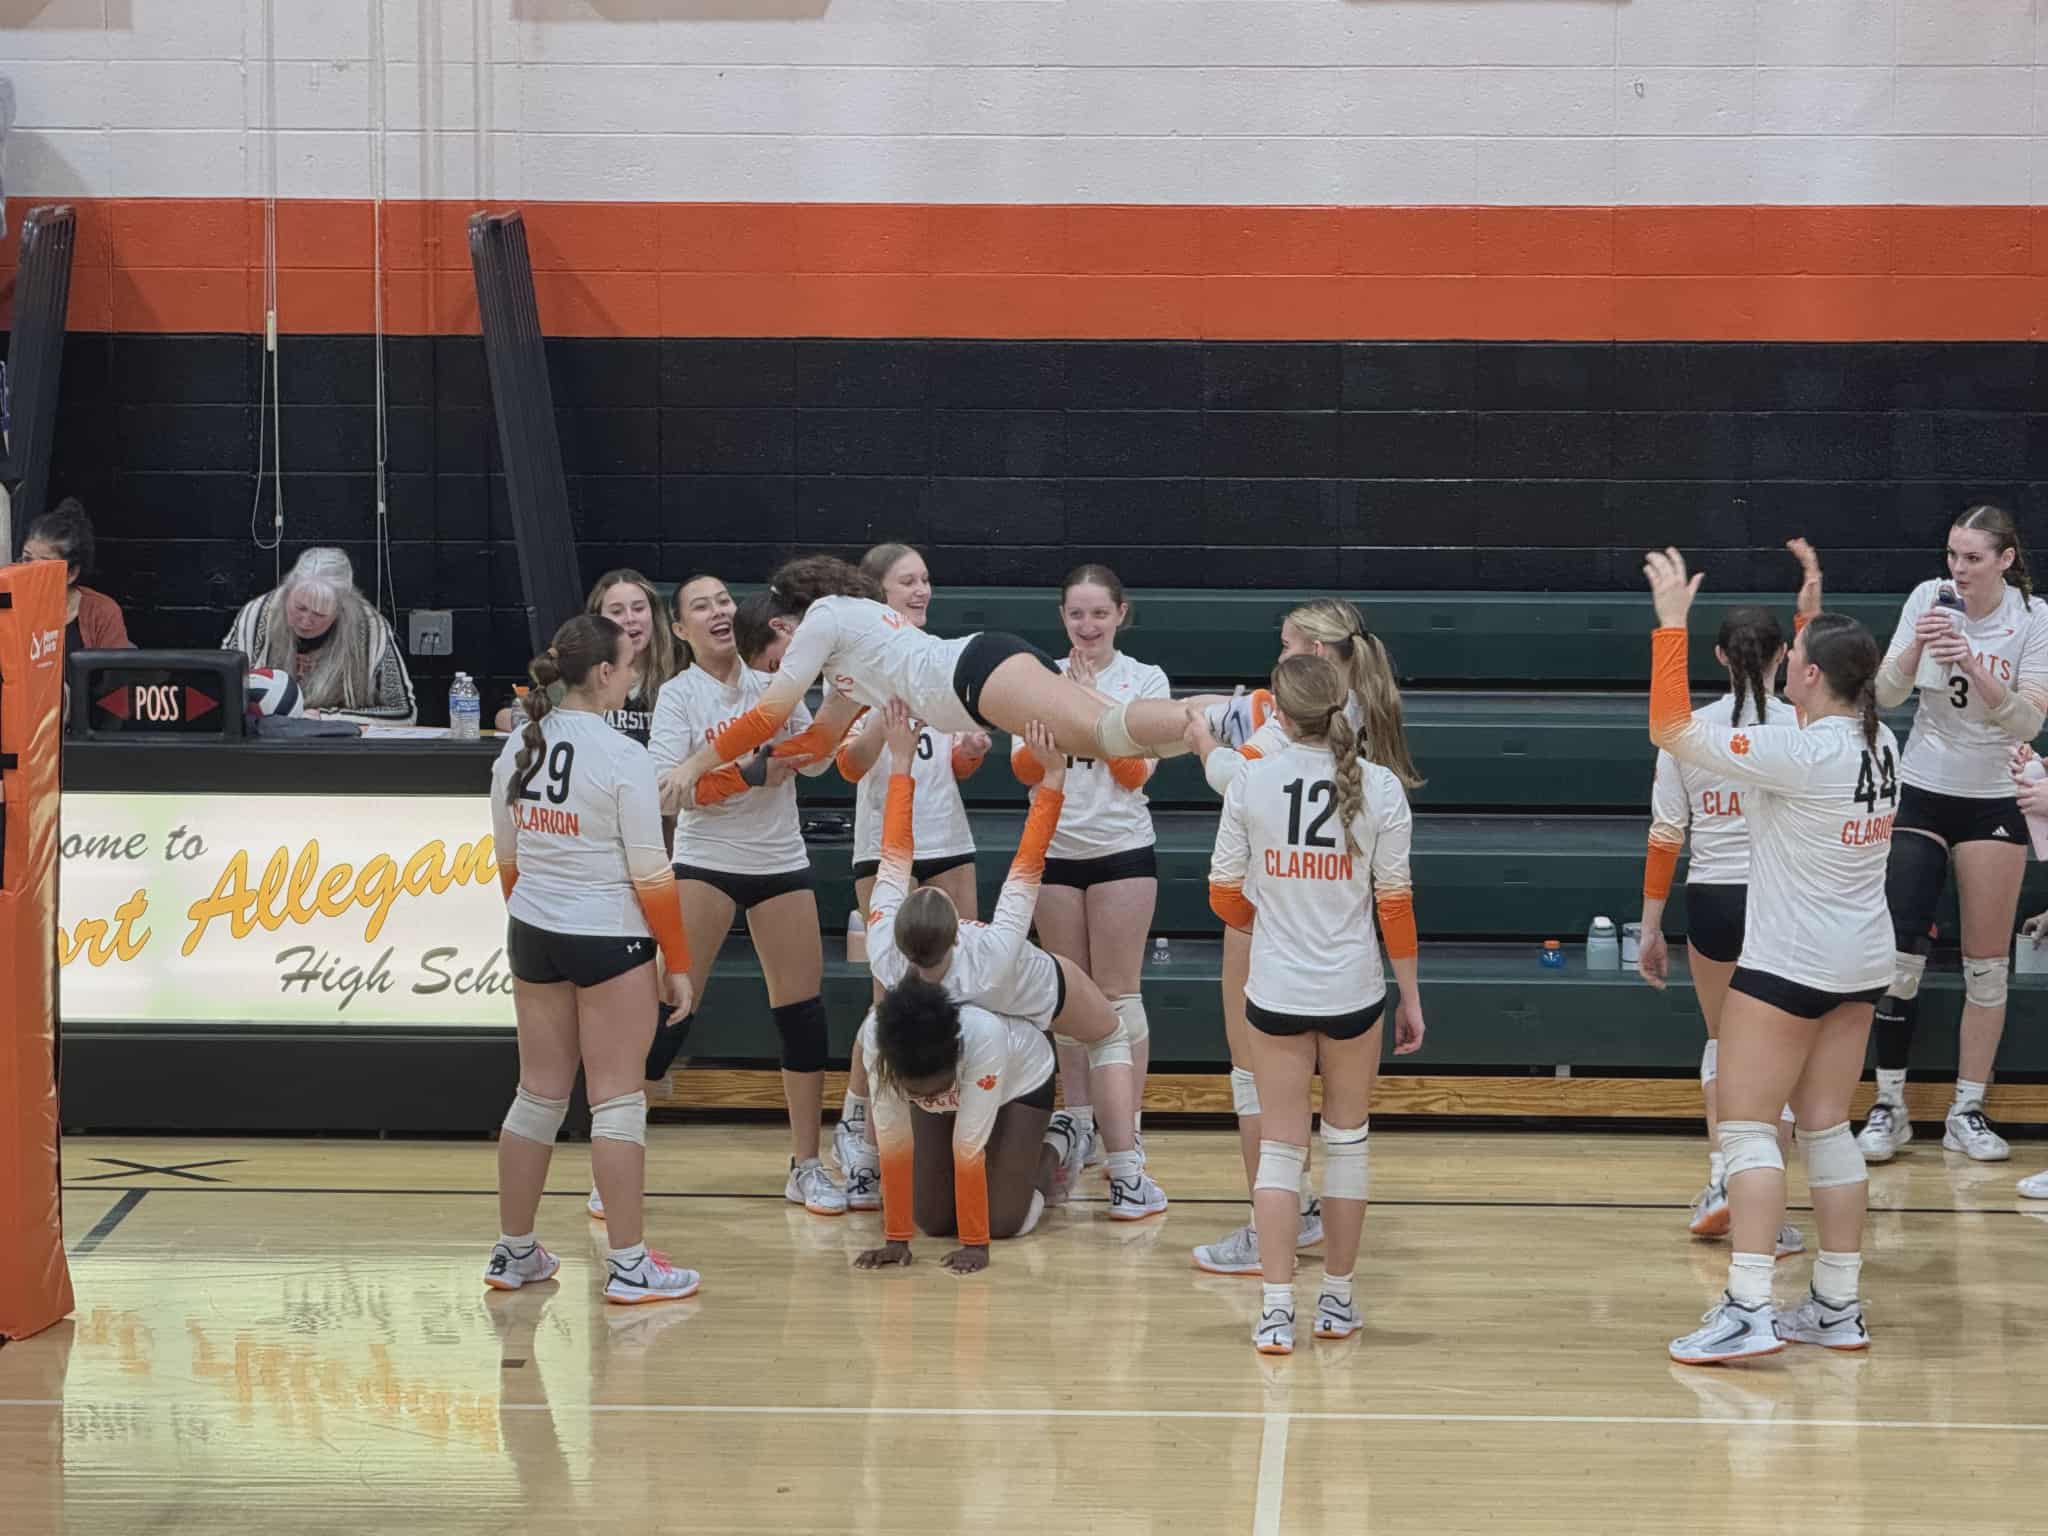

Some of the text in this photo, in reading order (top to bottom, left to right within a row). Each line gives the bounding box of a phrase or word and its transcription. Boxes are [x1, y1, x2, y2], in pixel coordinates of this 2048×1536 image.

[135, 685, 179, 721] POSS
[1948, 676, 1969, 709] 3
[602, 707, 654, 731] ARSIT
[519, 741, 575, 804] 29
[1855, 745, 1897, 813] 44
[513, 803, 580, 837] CLARION
[1283, 778, 1338, 848] 12
[1702, 791, 1746, 817] CLA
[165, 824, 208, 861] to
[1264, 848, 1353, 881] CLARION
[275, 945, 395, 1012] High
